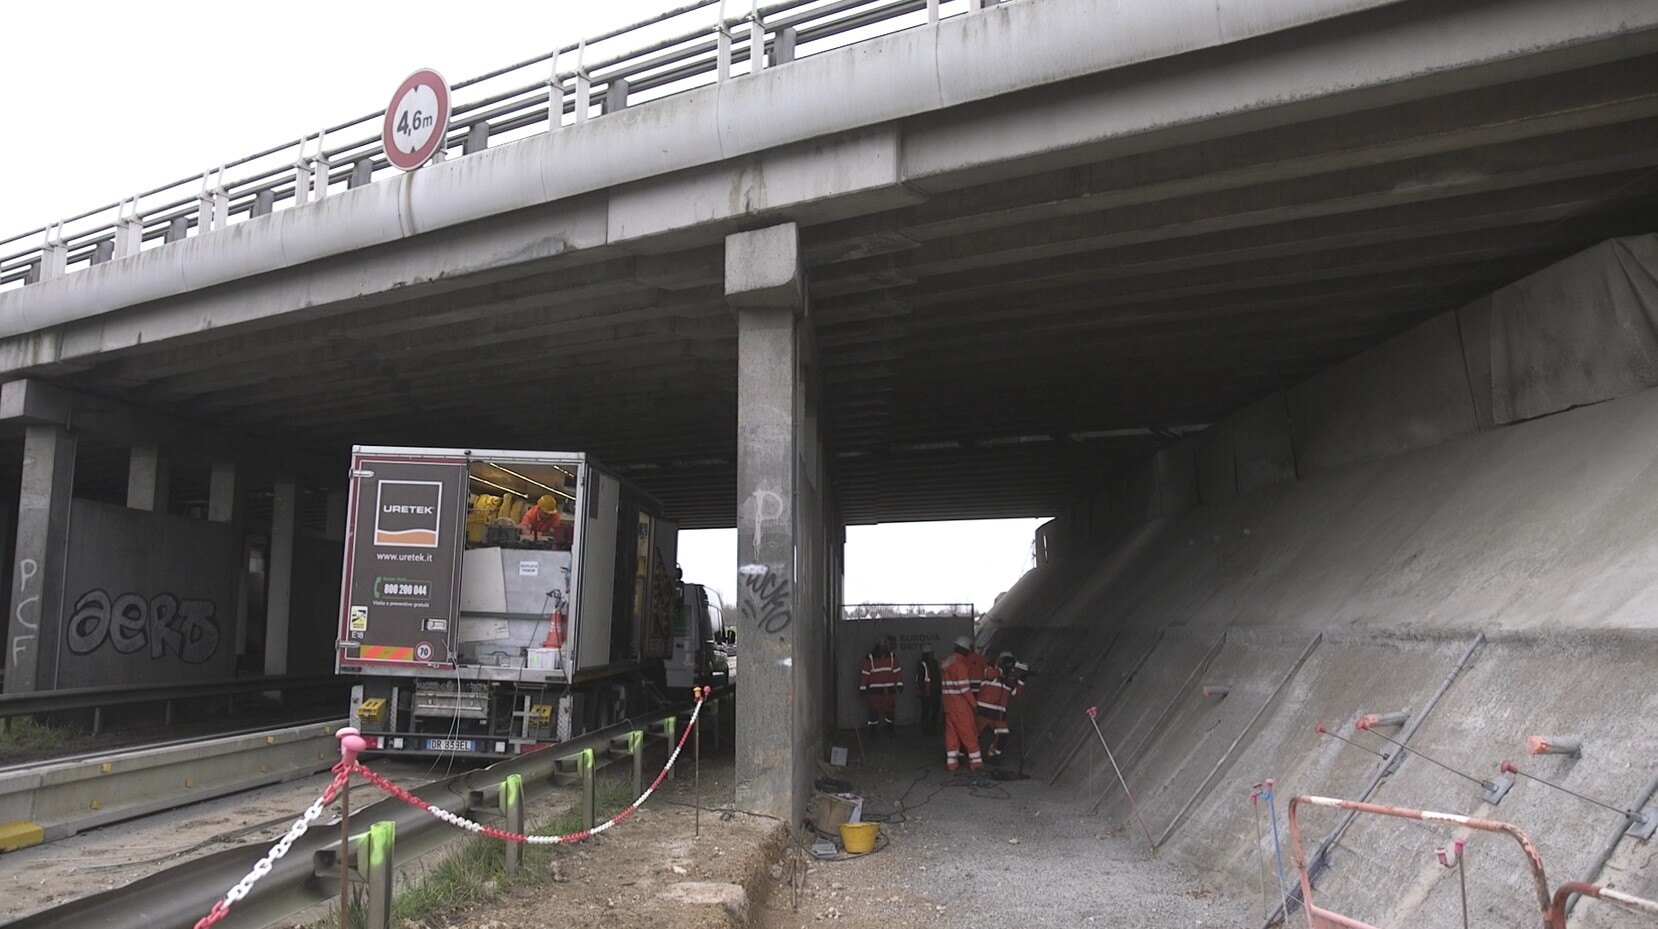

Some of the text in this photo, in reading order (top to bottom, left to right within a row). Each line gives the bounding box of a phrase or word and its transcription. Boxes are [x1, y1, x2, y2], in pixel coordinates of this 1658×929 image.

[397, 110, 433, 136] 4,6m
[383, 505, 433, 514] URETEK
[376, 553, 433, 562] www.uretek.it
[384, 583, 427, 596] 800 200 044
[420, 648, 429, 656] 70
